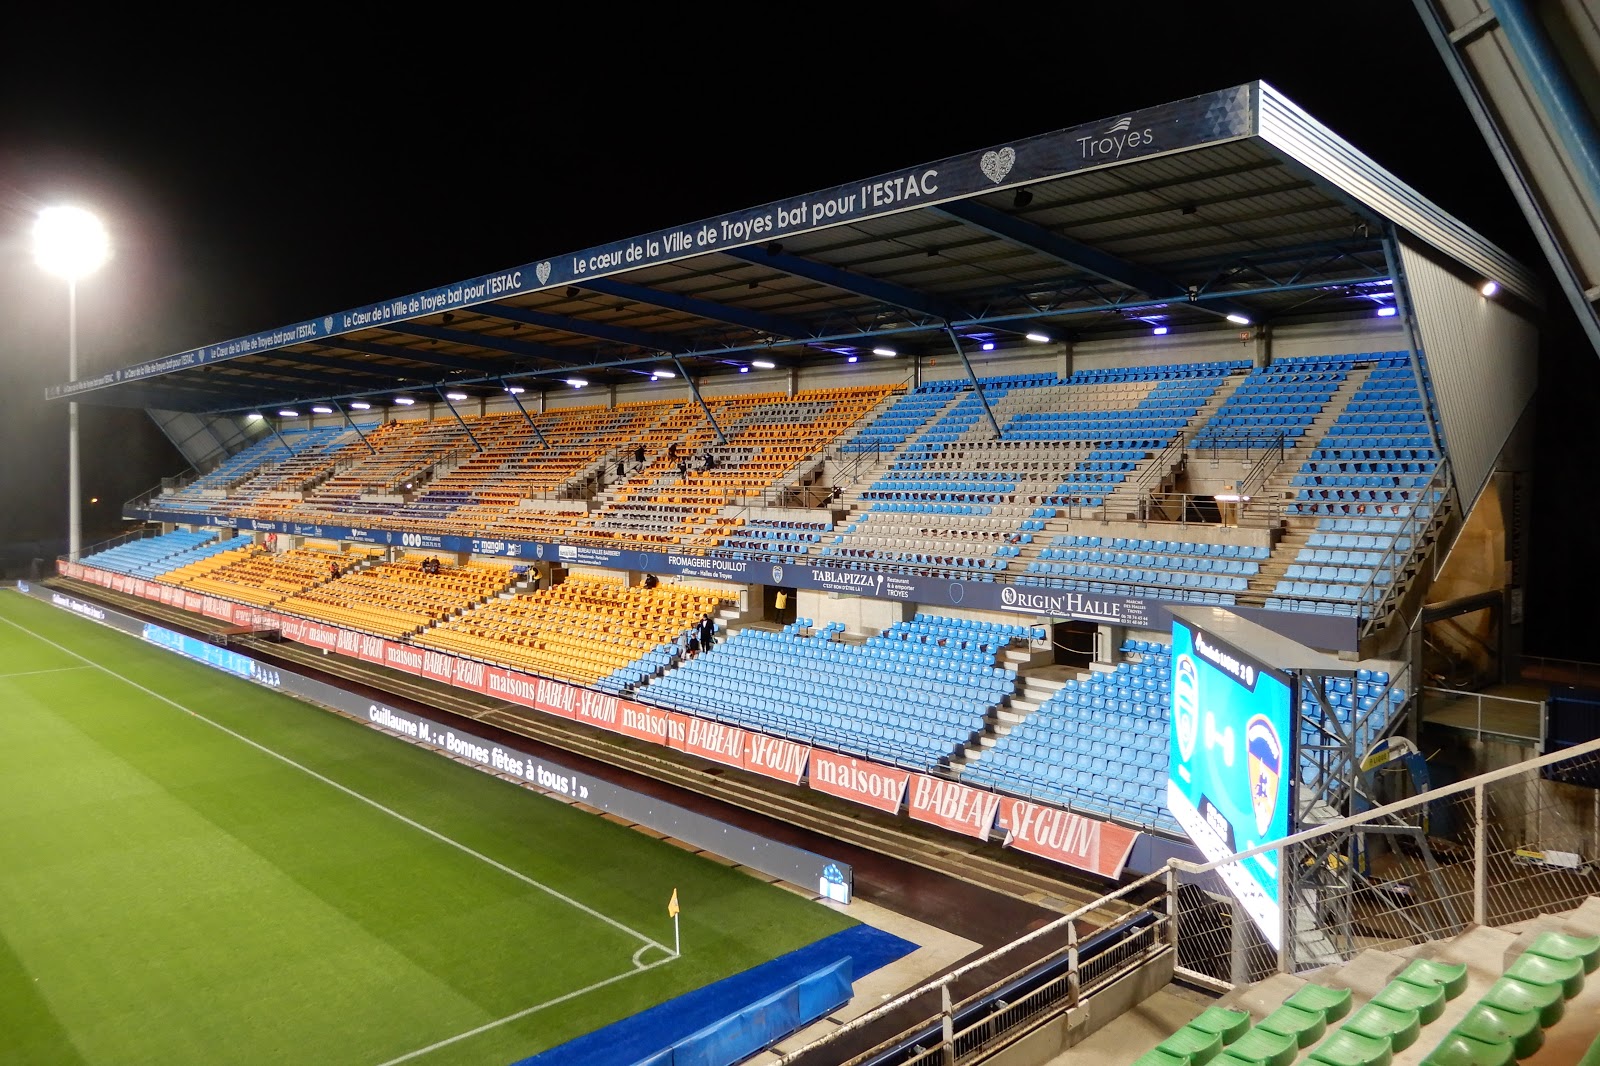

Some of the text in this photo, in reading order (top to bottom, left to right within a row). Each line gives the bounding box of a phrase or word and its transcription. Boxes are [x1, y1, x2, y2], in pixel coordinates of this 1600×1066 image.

[1076, 127, 1153, 158] Troyes
[573, 257, 587, 274] Le
[589, 250, 623, 269] cœur
[625, 243, 643, 263] de
[646, 239, 659, 258] la
[662, 231, 693, 254] Ville
[696, 225, 718, 246] de
[721, 214, 773, 241] Troyes
[777, 202, 807, 228] bat
[812, 194, 857, 225] pour
[343, 315, 352, 328] Le
[372, 308, 382, 321] de
[383, 306, 391, 319] la
[391, 301, 408, 317] Ville
[408, 299, 420, 313] de
[420, 293, 446, 311] Troyes
[447, 286, 463, 304] bat
[464, 284, 485, 303] pour
[668, 556, 747, 572] FROMAGERIE POUILLOT
[811, 570, 875, 587] TABLAPIZZA
[886, 589, 909, 598] TROYES
[309, 624, 337, 646] maisons
[388, 644, 422, 669] maisons
[489, 672, 535, 700] maisons
[623, 706, 686, 741] maisons
[369, 705, 418, 737] Guillaume
[419, 721, 431, 742] M.
[446, 732, 490, 764] Bonnes
[491, 747, 524, 776] fêtes
[525, 759, 535, 781] à
[537, 765, 569, 793] tous
